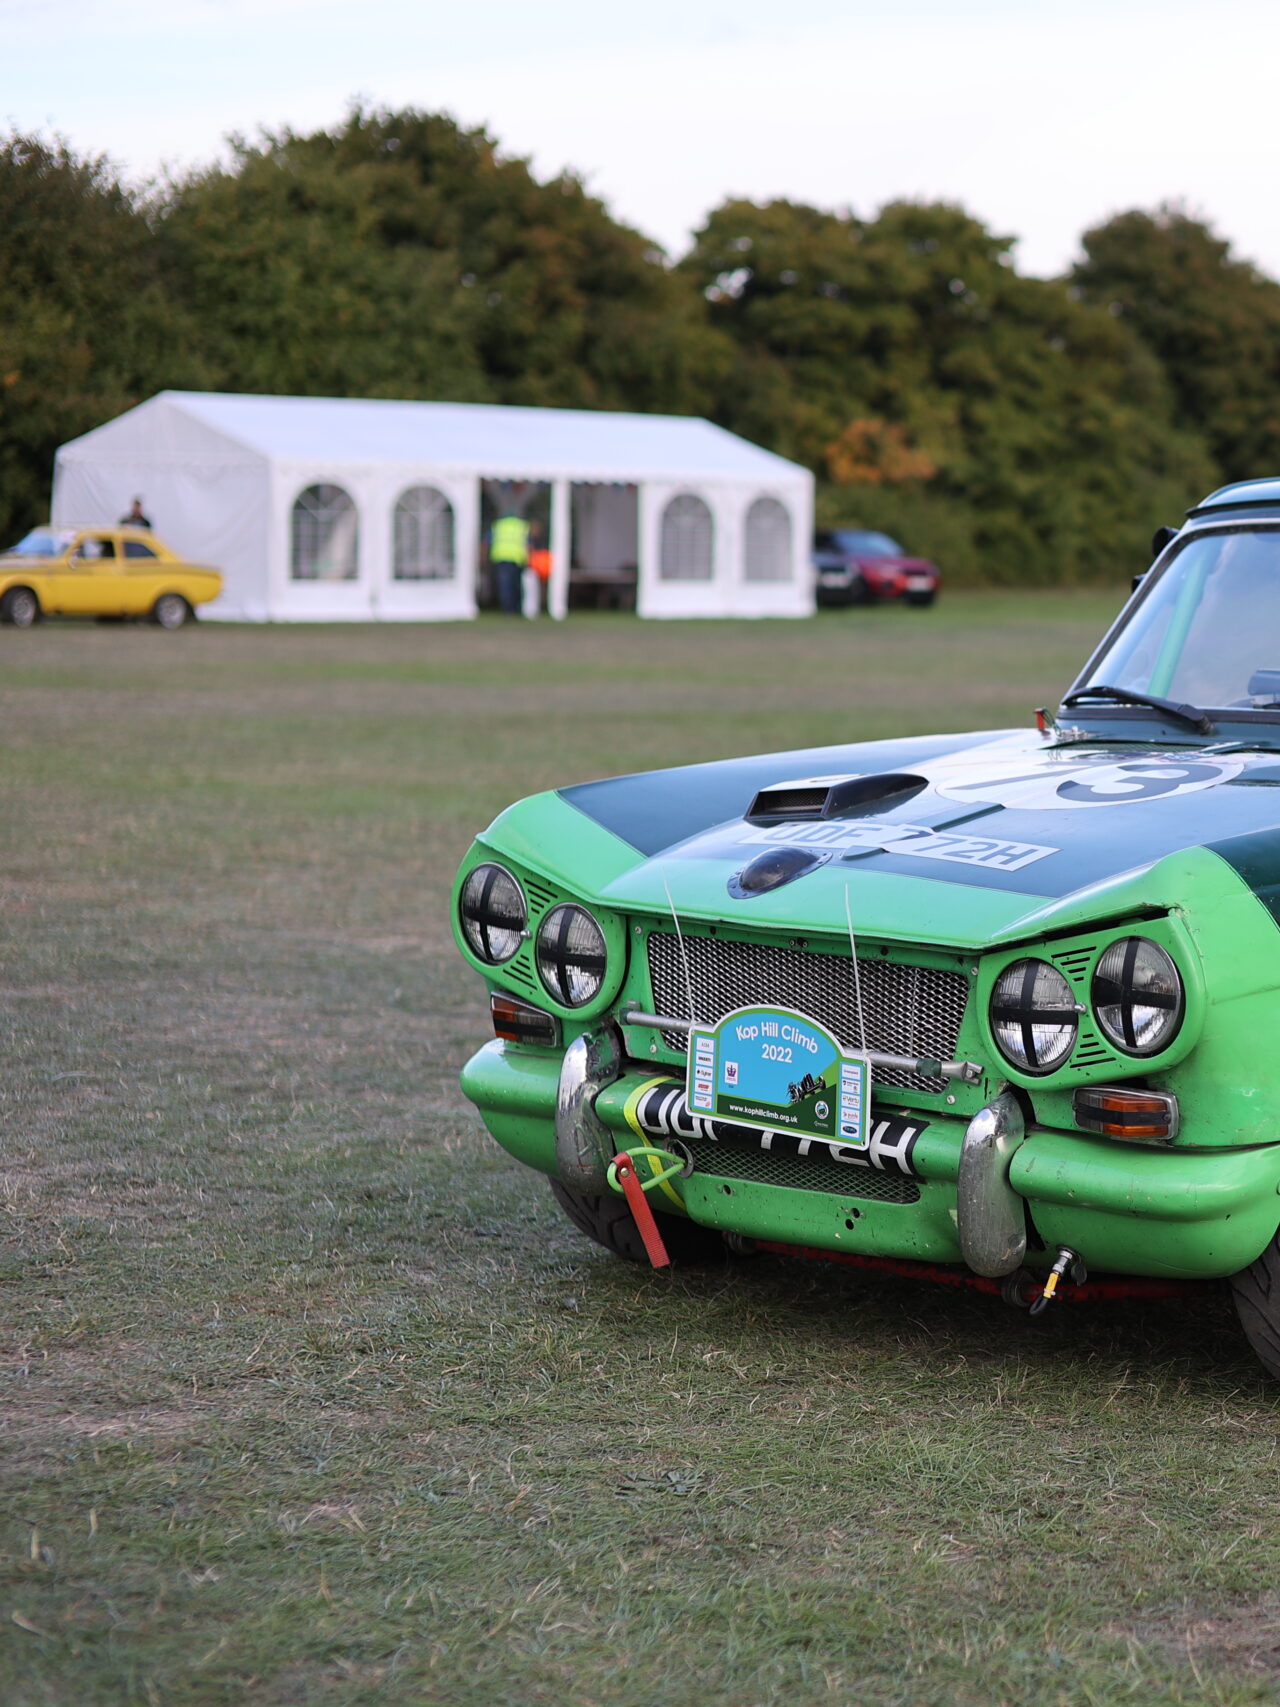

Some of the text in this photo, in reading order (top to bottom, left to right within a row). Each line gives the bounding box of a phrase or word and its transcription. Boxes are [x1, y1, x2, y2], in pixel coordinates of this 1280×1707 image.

[763, 824, 1037, 865] UDF 772H
[736, 1021, 818, 1054] Kop Hill Climb
[761, 1043, 793, 1063] 2022
[729, 1104, 798, 1123] www.kophillclimb.org.uk
